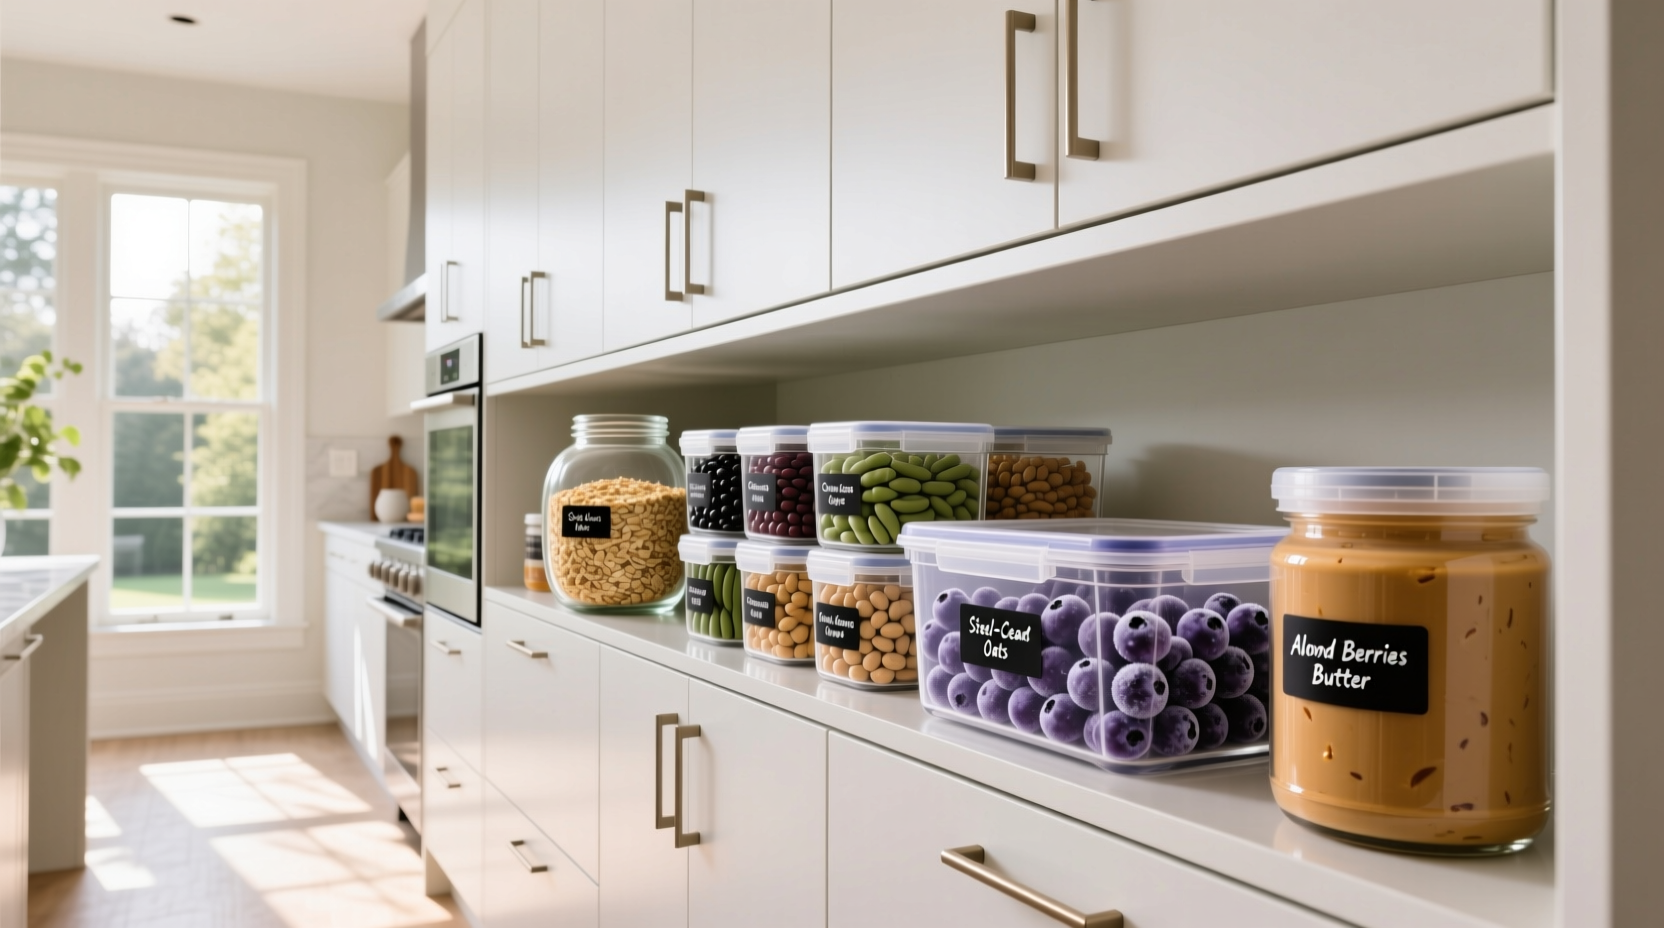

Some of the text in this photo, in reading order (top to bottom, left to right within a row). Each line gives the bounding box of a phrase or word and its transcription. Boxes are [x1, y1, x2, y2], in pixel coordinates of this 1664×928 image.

[983, 639, 1009, 660] Oats
[1341, 639, 1408, 667] Berries
[1311, 662, 1372, 690] Butter
